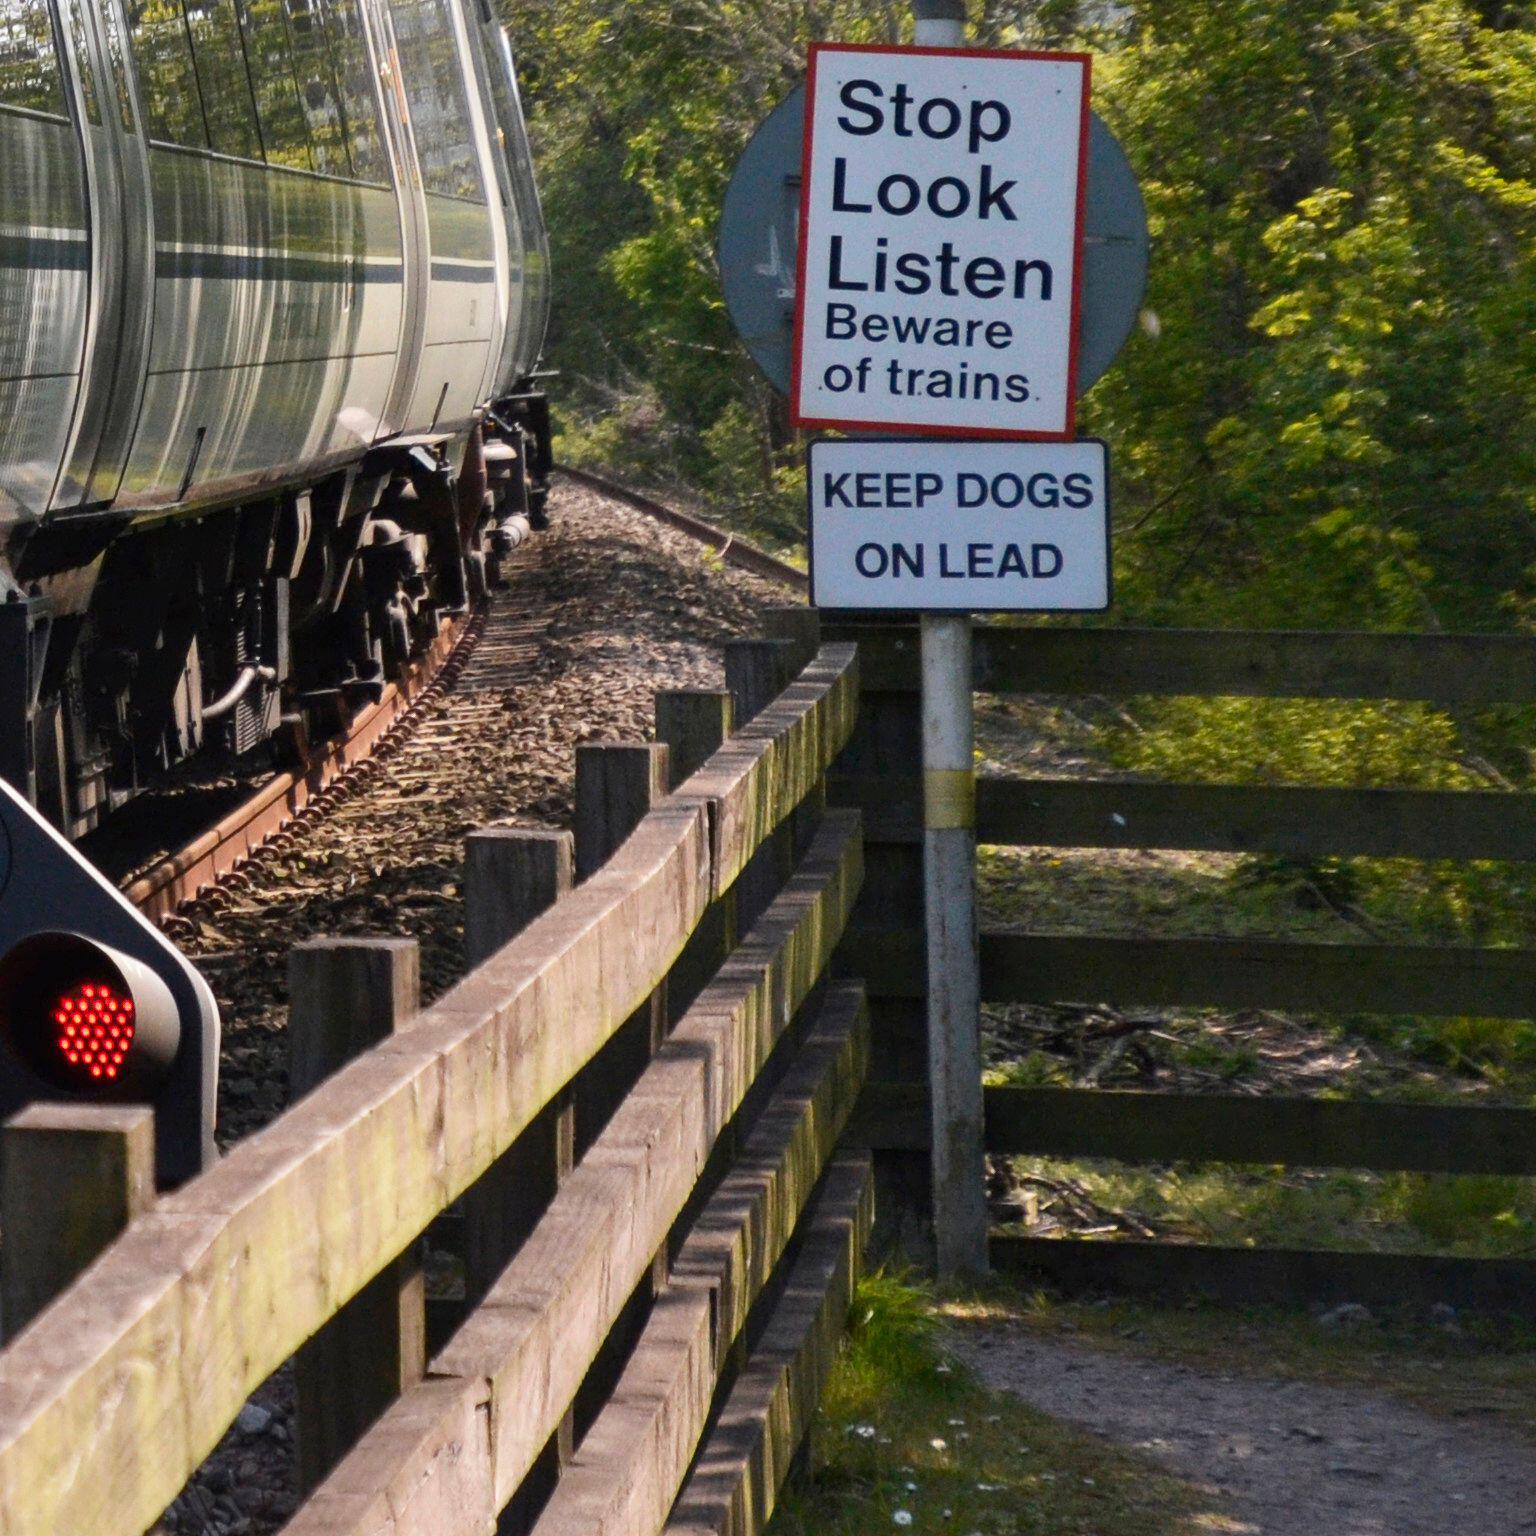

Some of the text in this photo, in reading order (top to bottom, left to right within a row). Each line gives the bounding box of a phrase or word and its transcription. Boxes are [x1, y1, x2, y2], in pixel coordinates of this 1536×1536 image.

[838, 79, 1011, 154] Stop
[833, 157, 1017, 221] Look
[829, 235, 1053, 300] Listen
[826, 303, 1012, 349] Beware
[824, 357, 1029, 403] of trains
[824, 473, 1093, 509] KEEP DOGS
[855, 542, 1063, 578] ON LEAD
